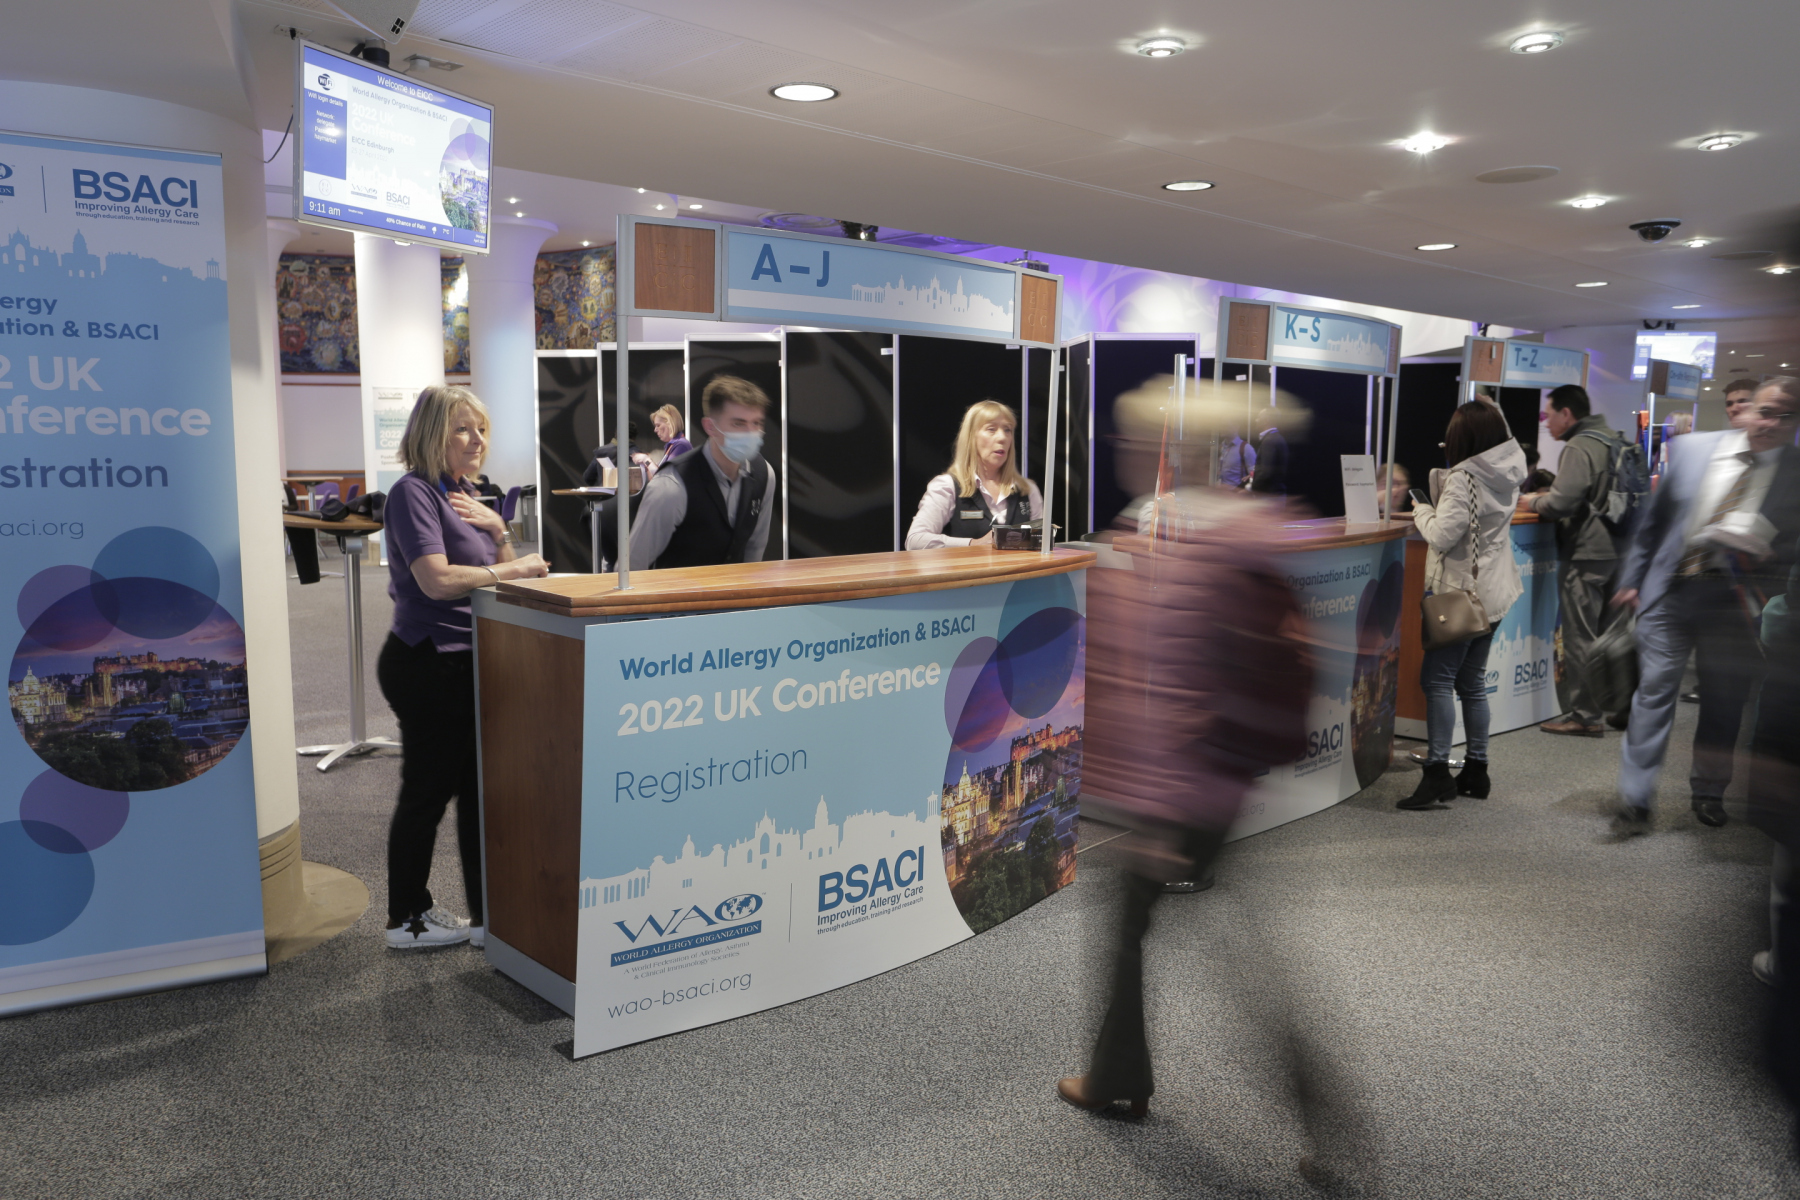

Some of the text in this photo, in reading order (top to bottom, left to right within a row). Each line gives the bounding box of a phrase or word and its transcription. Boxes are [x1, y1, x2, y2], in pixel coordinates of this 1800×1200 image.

[318, 94, 329, 103] login
[329, 97, 344, 107] details
[377, 75, 434, 102] Welcome to EICC
[351, 102, 394, 126] 2022 UK
[352, 86, 370, 97] World
[370, 92, 391, 105] Allergy
[391, 98, 427, 115] Organization
[432, 111, 448, 122] BSACI
[351, 116, 416, 147] Conference
[351, 135, 395, 155] EICC Edinburgh
[72, 168, 199, 209] BSACI
[386, 191, 410, 206] BSACI
[74, 200, 199, 219] Improving Allergy Care
[75, 211, 101, 219] through
[135, 216, 160, 224] training
[309, 200, 341, 216] 9:11 am
[396, 218, 411, 227] Chance
[417, 222, 426, 230] Rain
[0, 295, 58, 315] ergy
[62, 319, 80, 338] &
[87, 321, 159, 340] BSACI
[28, 355, 104, 392] UK
[0, 394, 211, 436] ference
[379, 430, 402, 439] 2022
[0, 457, 169, 489] stration
[0, 519, 84, 539] aci.org
[1287, 562, 1371, 590] Organization & BSACI
[1301, 594, 1356, 619] nference
[619, 614, 976, 681] World Allergy Organization & BSACI
[1514, 658, 1548, 686] BSACI
[617, 661, 941, 737] 2022 UK Conference
[1300, 722, 1344, 759] SACI
[614, 748, 808, 804] Registration
[818, 845, 925, 913] BSACI
[612, 893, 763, 944] WAO
[817, 885, 924, 926] Improving Allergy Care
[817, 923, 841, 935] through
[870, 907, 891, 919] training
[891, 903, 901, 913] and
[901, 896, 924, 909] research
[613, 923, 760, 964] WORLD ALLERGY ORGANIZATION
[631, 963, 652, 973] World
[653, 955, 690, 968] Federation
[724, 941, 750, 951] Asthma
[640, 968, 666, 979] Clinical
[667, 958, 710, 973] Immunology
[710, 951, 740, 962] Societies
[607, 972, 752, 1019] wao-bsaci.org
